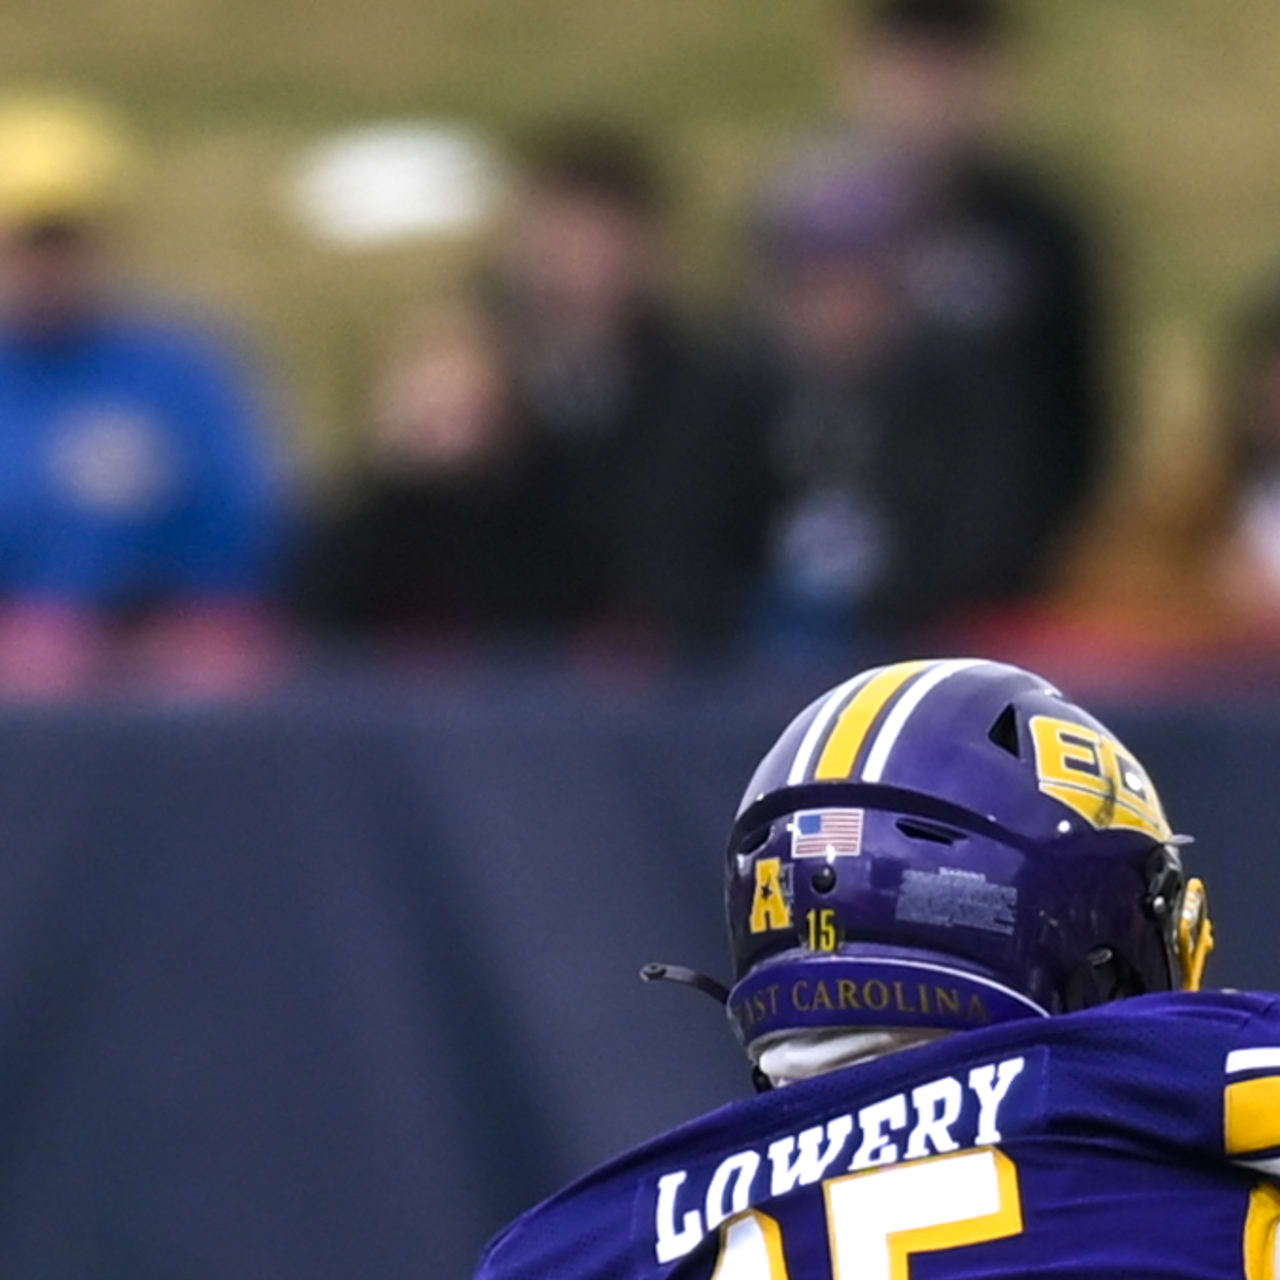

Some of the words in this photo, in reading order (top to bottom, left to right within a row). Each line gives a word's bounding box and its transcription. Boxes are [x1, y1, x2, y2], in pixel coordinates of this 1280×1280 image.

[806, 908, 836, 952] 15
[791, 978, 989, 1021] CAROLINA
[655, 1057, 1025, 1264] LOWERY
